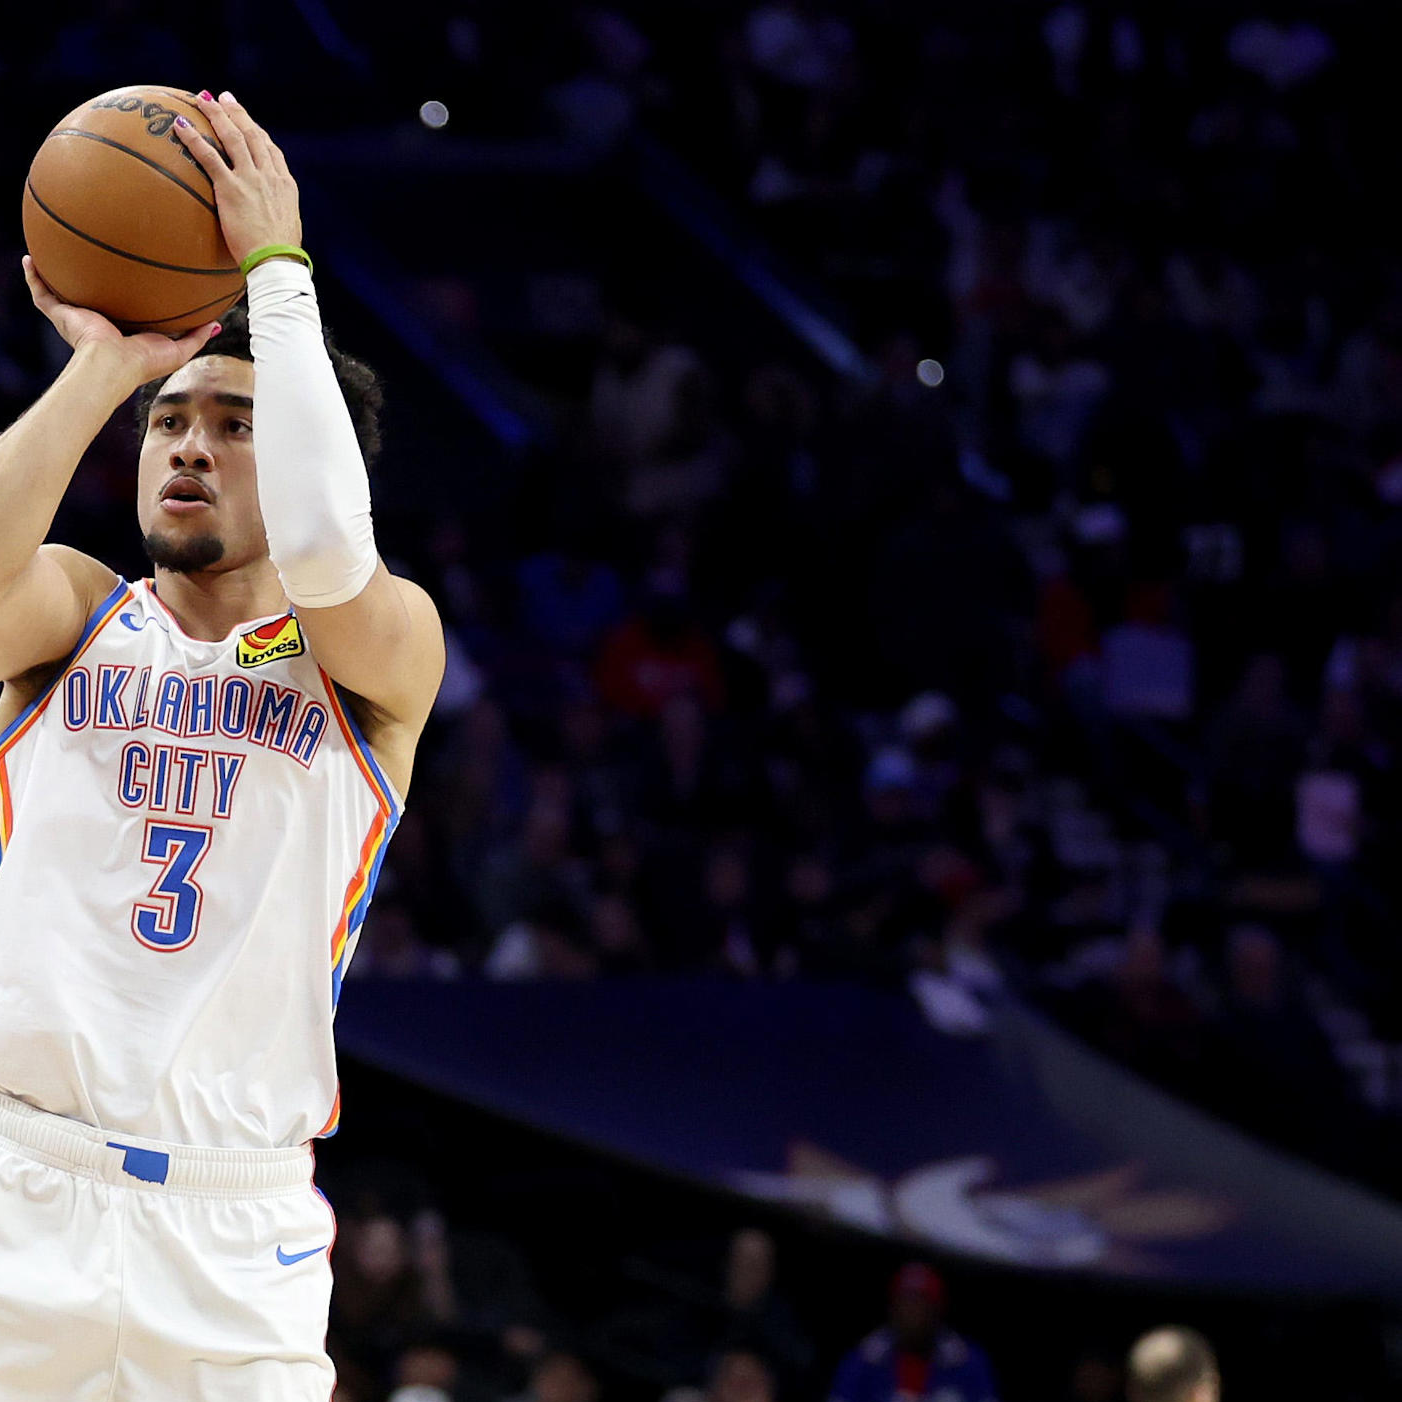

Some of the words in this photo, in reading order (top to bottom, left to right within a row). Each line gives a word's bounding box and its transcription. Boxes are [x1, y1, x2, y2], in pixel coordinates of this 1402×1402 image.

[64, 664, 328, 769] OKLAHOMA
[119, 741, 246, 819] CITY
[130, 819, 214, 953] 3
